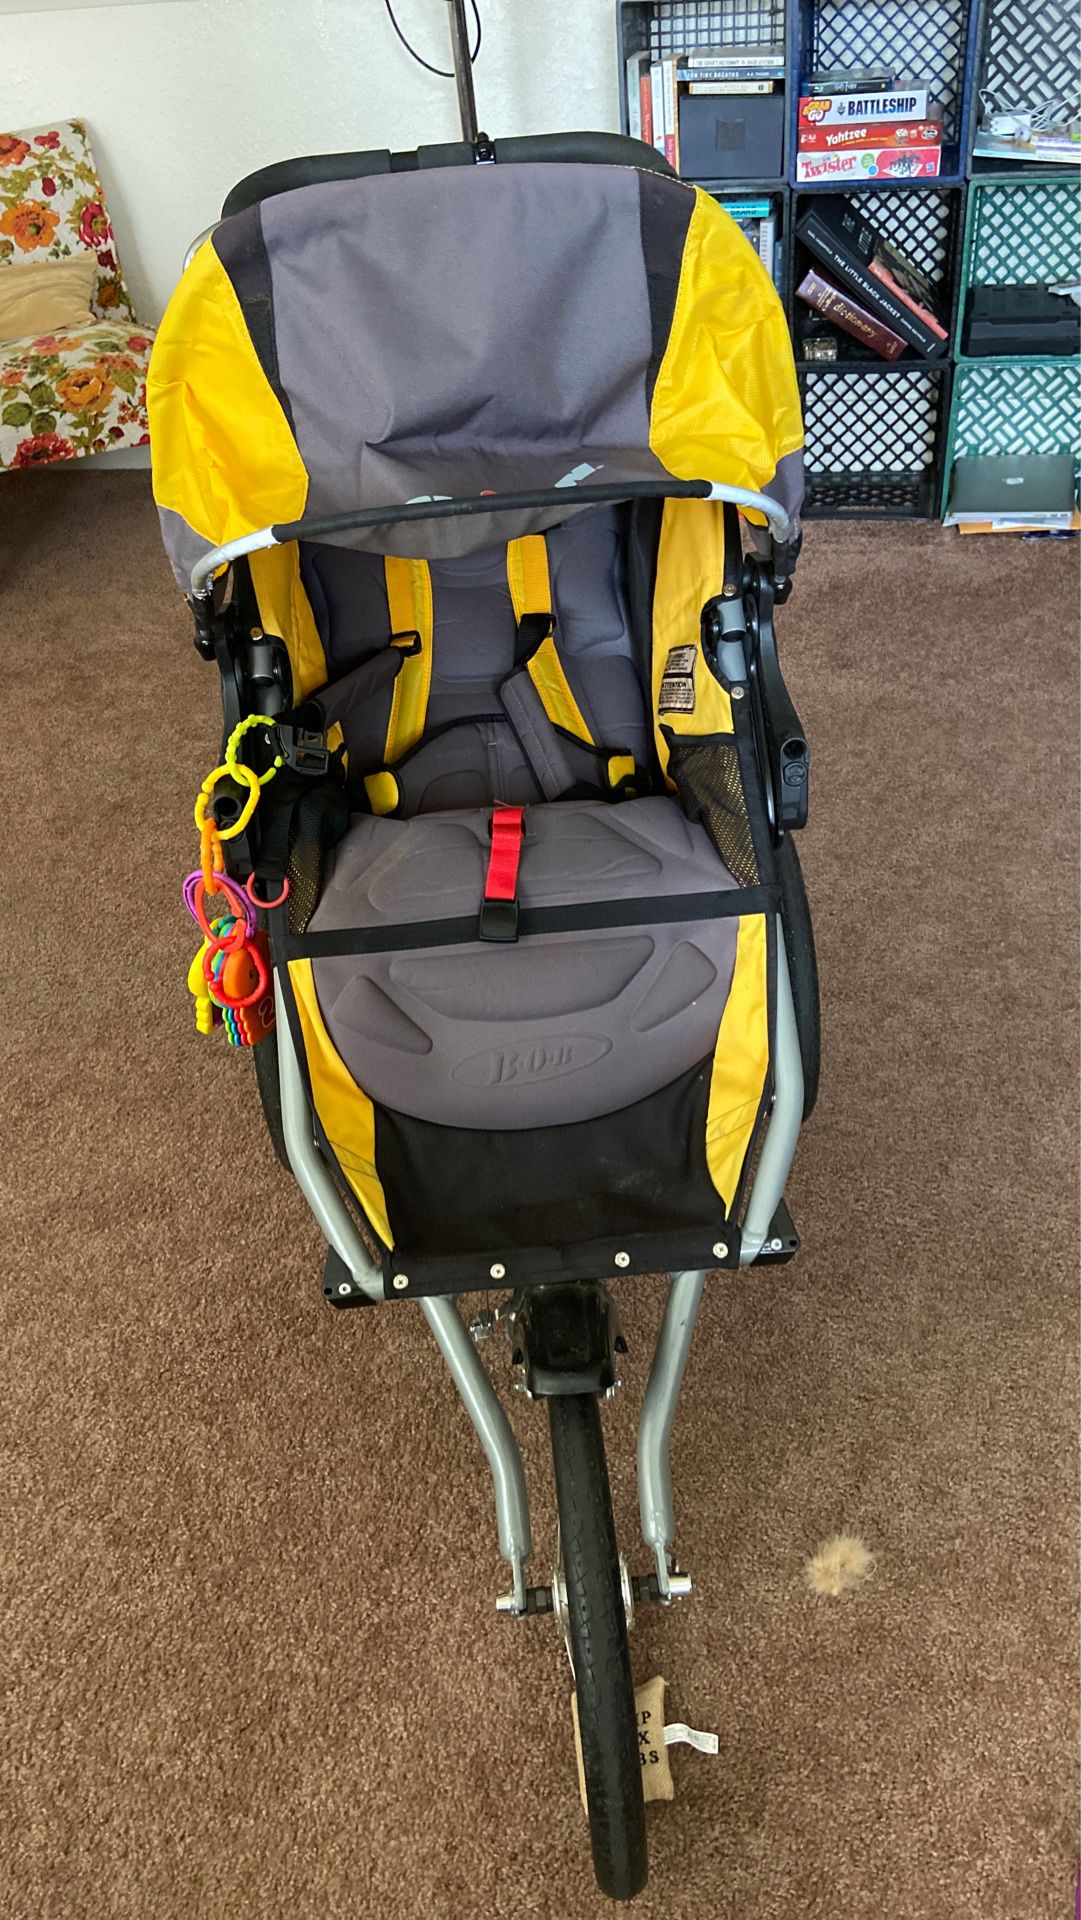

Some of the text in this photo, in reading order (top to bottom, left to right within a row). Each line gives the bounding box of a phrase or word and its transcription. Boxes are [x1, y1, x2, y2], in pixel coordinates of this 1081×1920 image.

[847, 97, 917, 116] BATTLESHIP
[825, 128, 868, 147] Yahtzee
[801, 156, 857, 179] Twister
[833, 254, 846, 268] THE
[844, 265, 863, 284] LITTLE
[862, 281, 881, 300] BLACK
[879, 299, 901, 319] JACKET
[833, 302, 878, 338] dictionary
